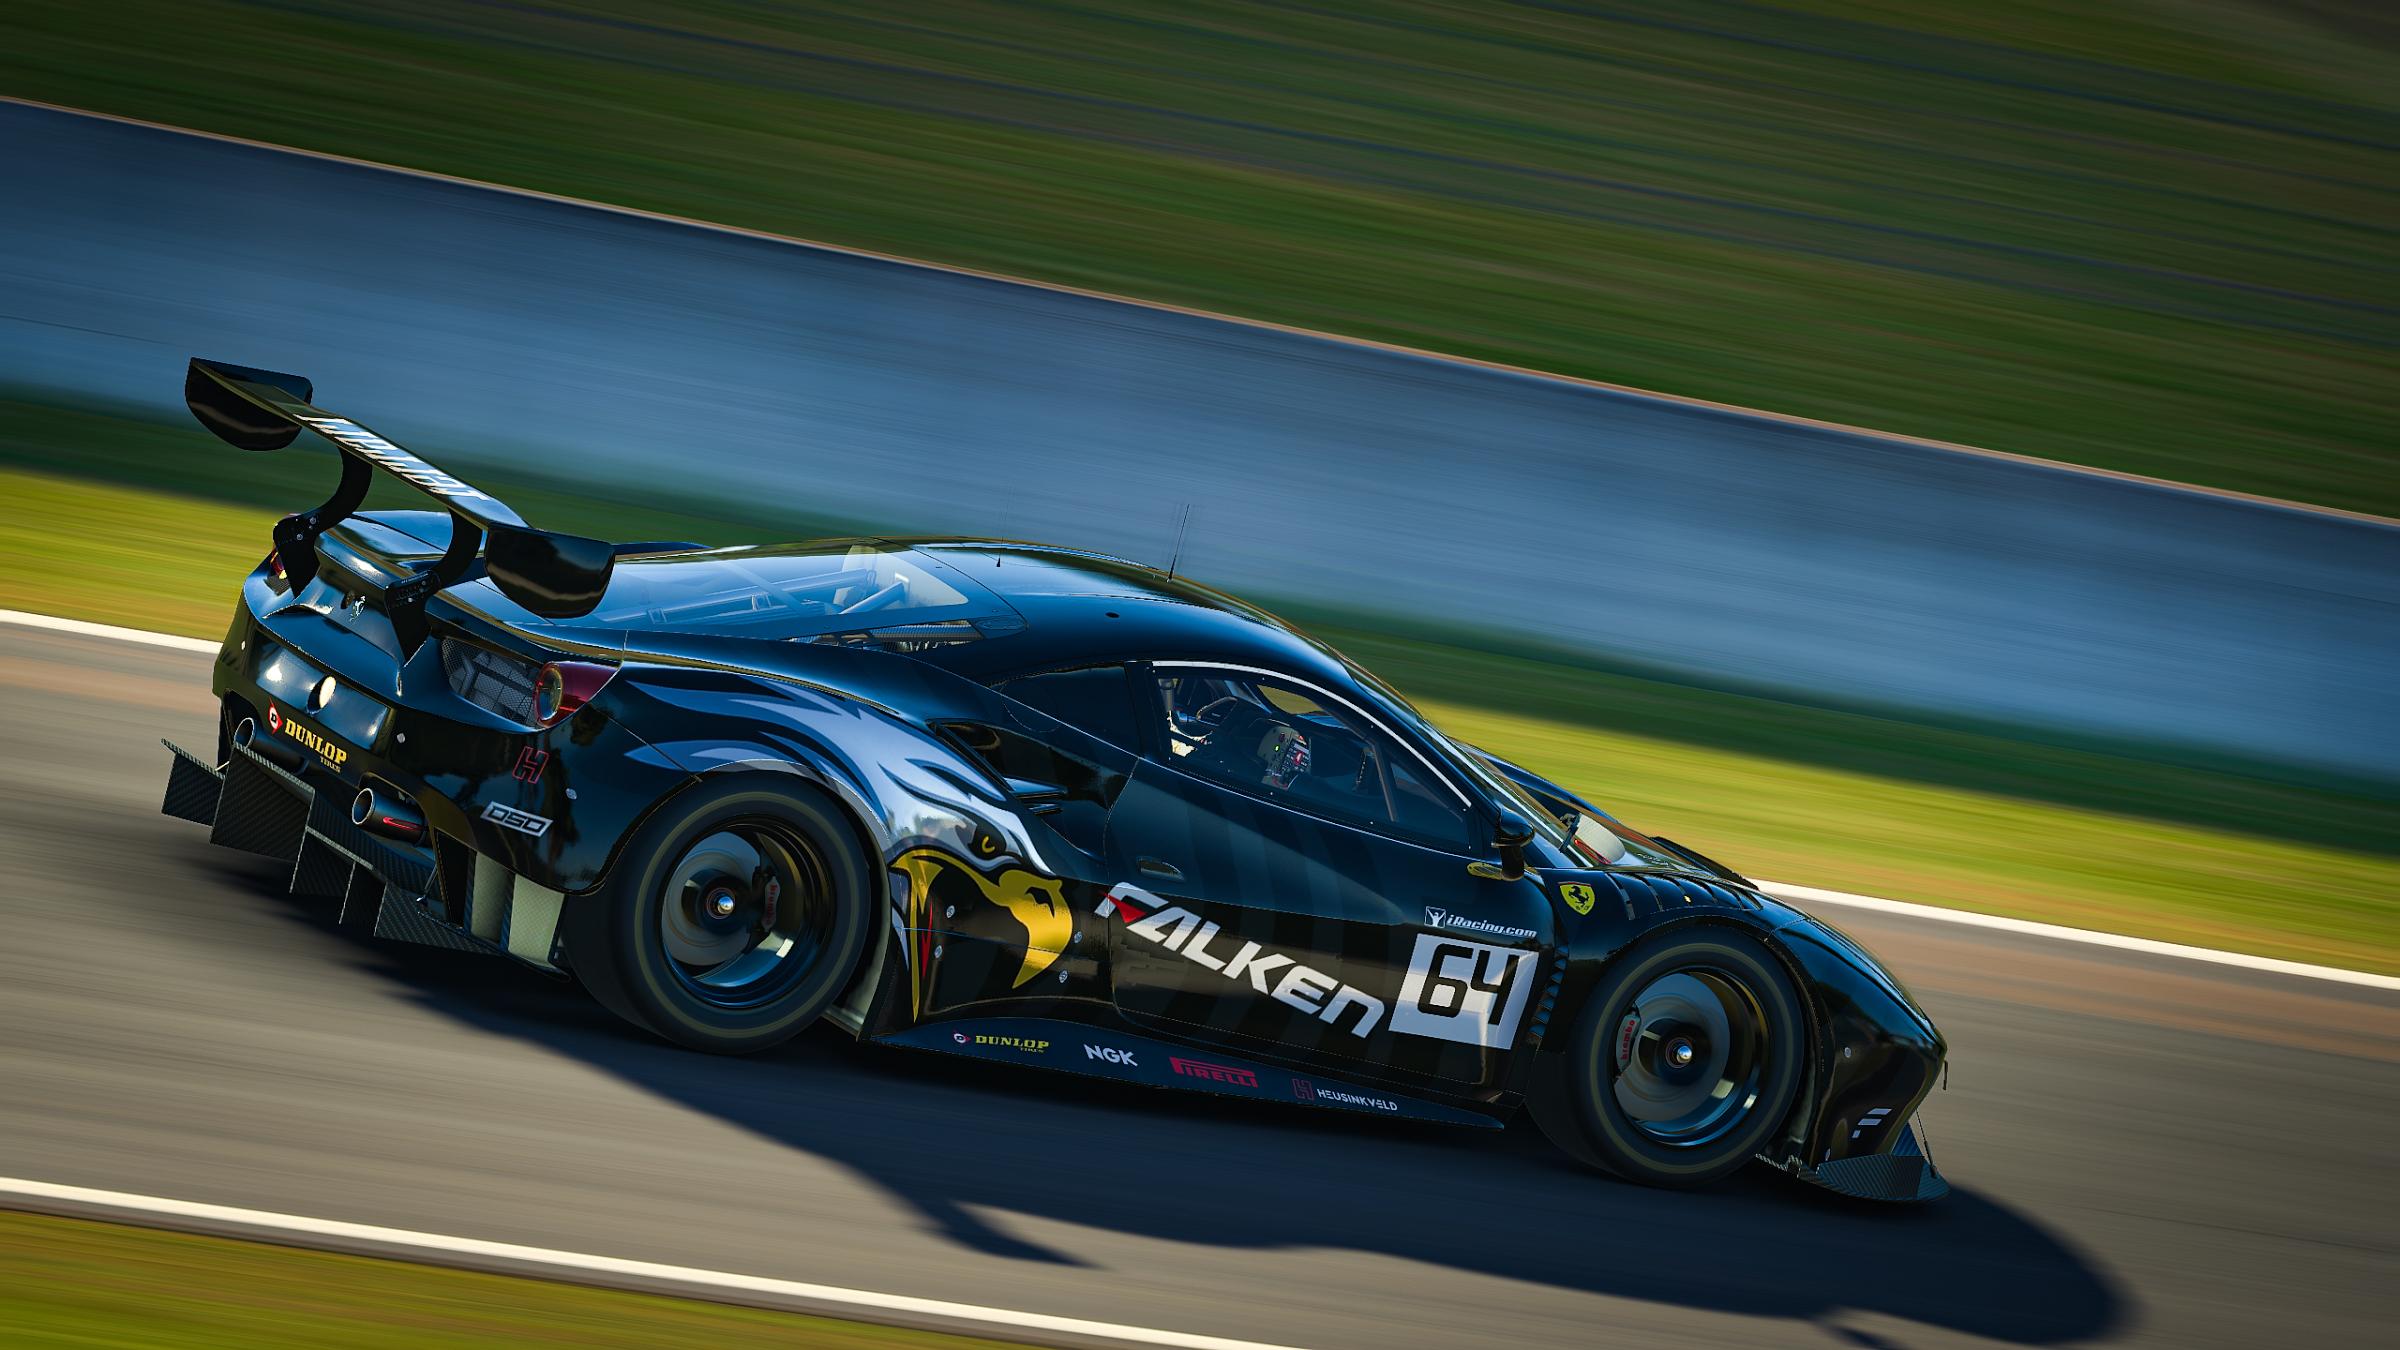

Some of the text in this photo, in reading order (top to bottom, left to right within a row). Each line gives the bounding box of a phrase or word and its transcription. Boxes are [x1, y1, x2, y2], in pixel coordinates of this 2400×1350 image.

[285, 718, 347, 764] DUNLOP
[1447, 914, 1538, 938] iRacing.com
[1094, 882, 1386, 1038] FALKEN
[1417, 943, 1520, 1026] 64
[975, 1035, 1049, 1048] DUNLOP
[1083, 1043, 1139, 1067] NGK
[1169, 1056, 1259, 1088] PIRELLI
[1317, 1088, 1398, 1111] HEUSINKVELD
